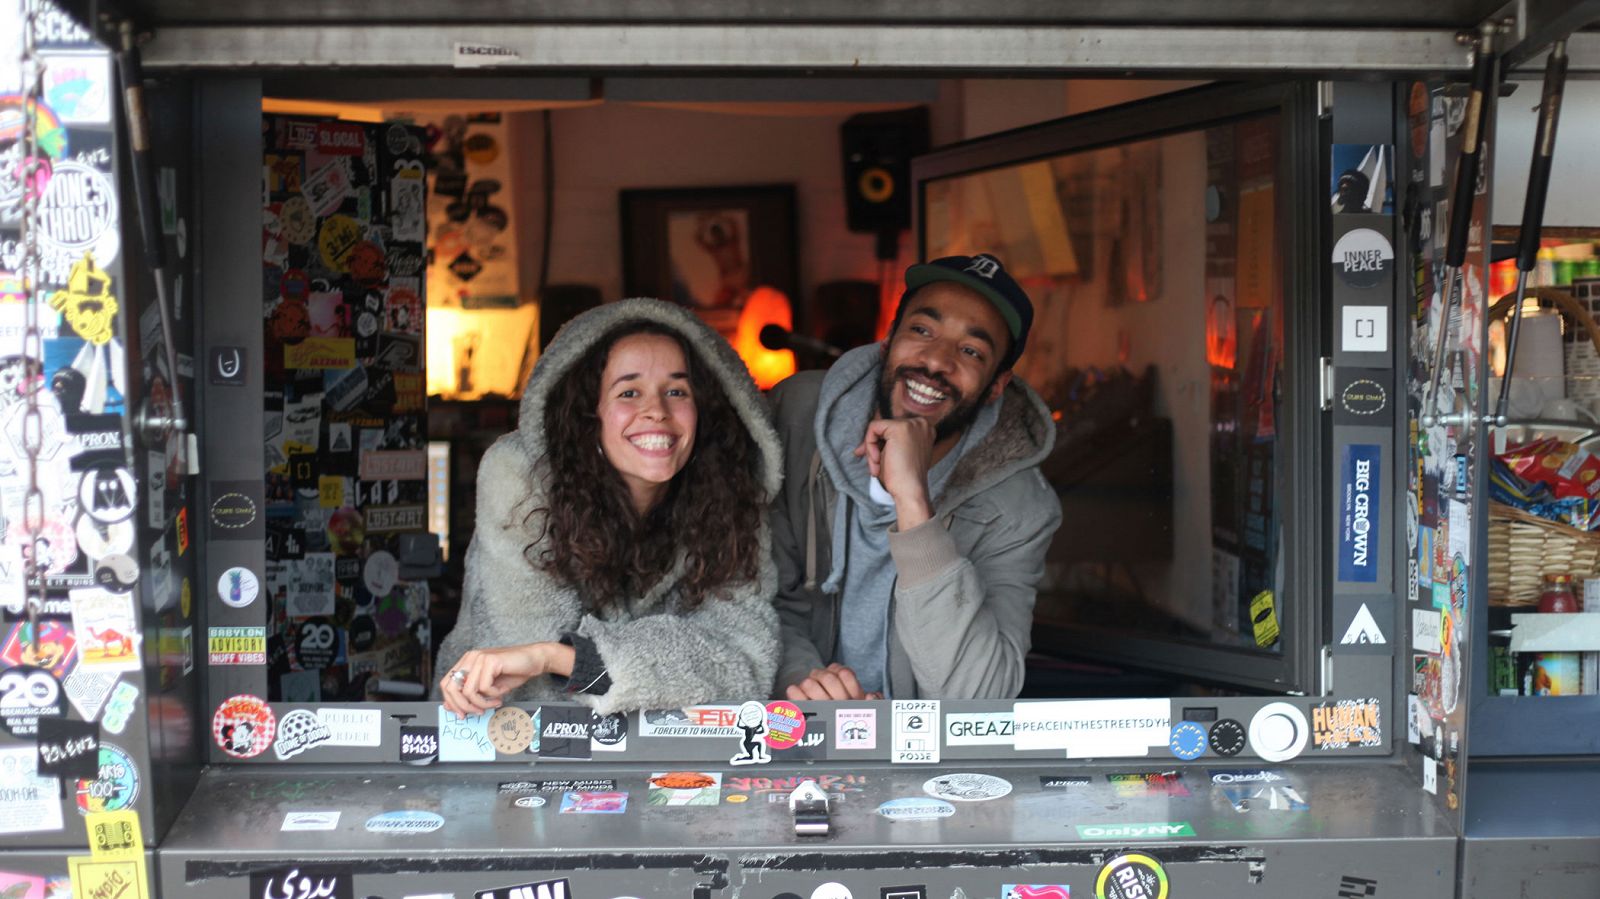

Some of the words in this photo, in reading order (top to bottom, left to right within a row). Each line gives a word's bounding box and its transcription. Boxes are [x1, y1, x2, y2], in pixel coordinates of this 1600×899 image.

[1344, 249, 1382, 261] INNER
[1343, 256, 1384, 272] PEACE
[1355, 459, 1370, 492] BIG
[1352, 493, 1370, 567] CROWN
[210, 628, 264, 637] BABYLON
[300, 623, 335, 649] 20
[211, 638, 263, 651] ADVISORY
[211, 653, 236, 664] NUFF
[238, 653, 264, 664] VIBES
[0, 671, 58, 708] 20
[324, 713, 374, 725] PUBLIC
[335, 731, 371, 742] RDER
[689, 726, 700, 735] TO
[443, 724, 492, 754] ALONE
[402, 744, 438, 755] SHOP
